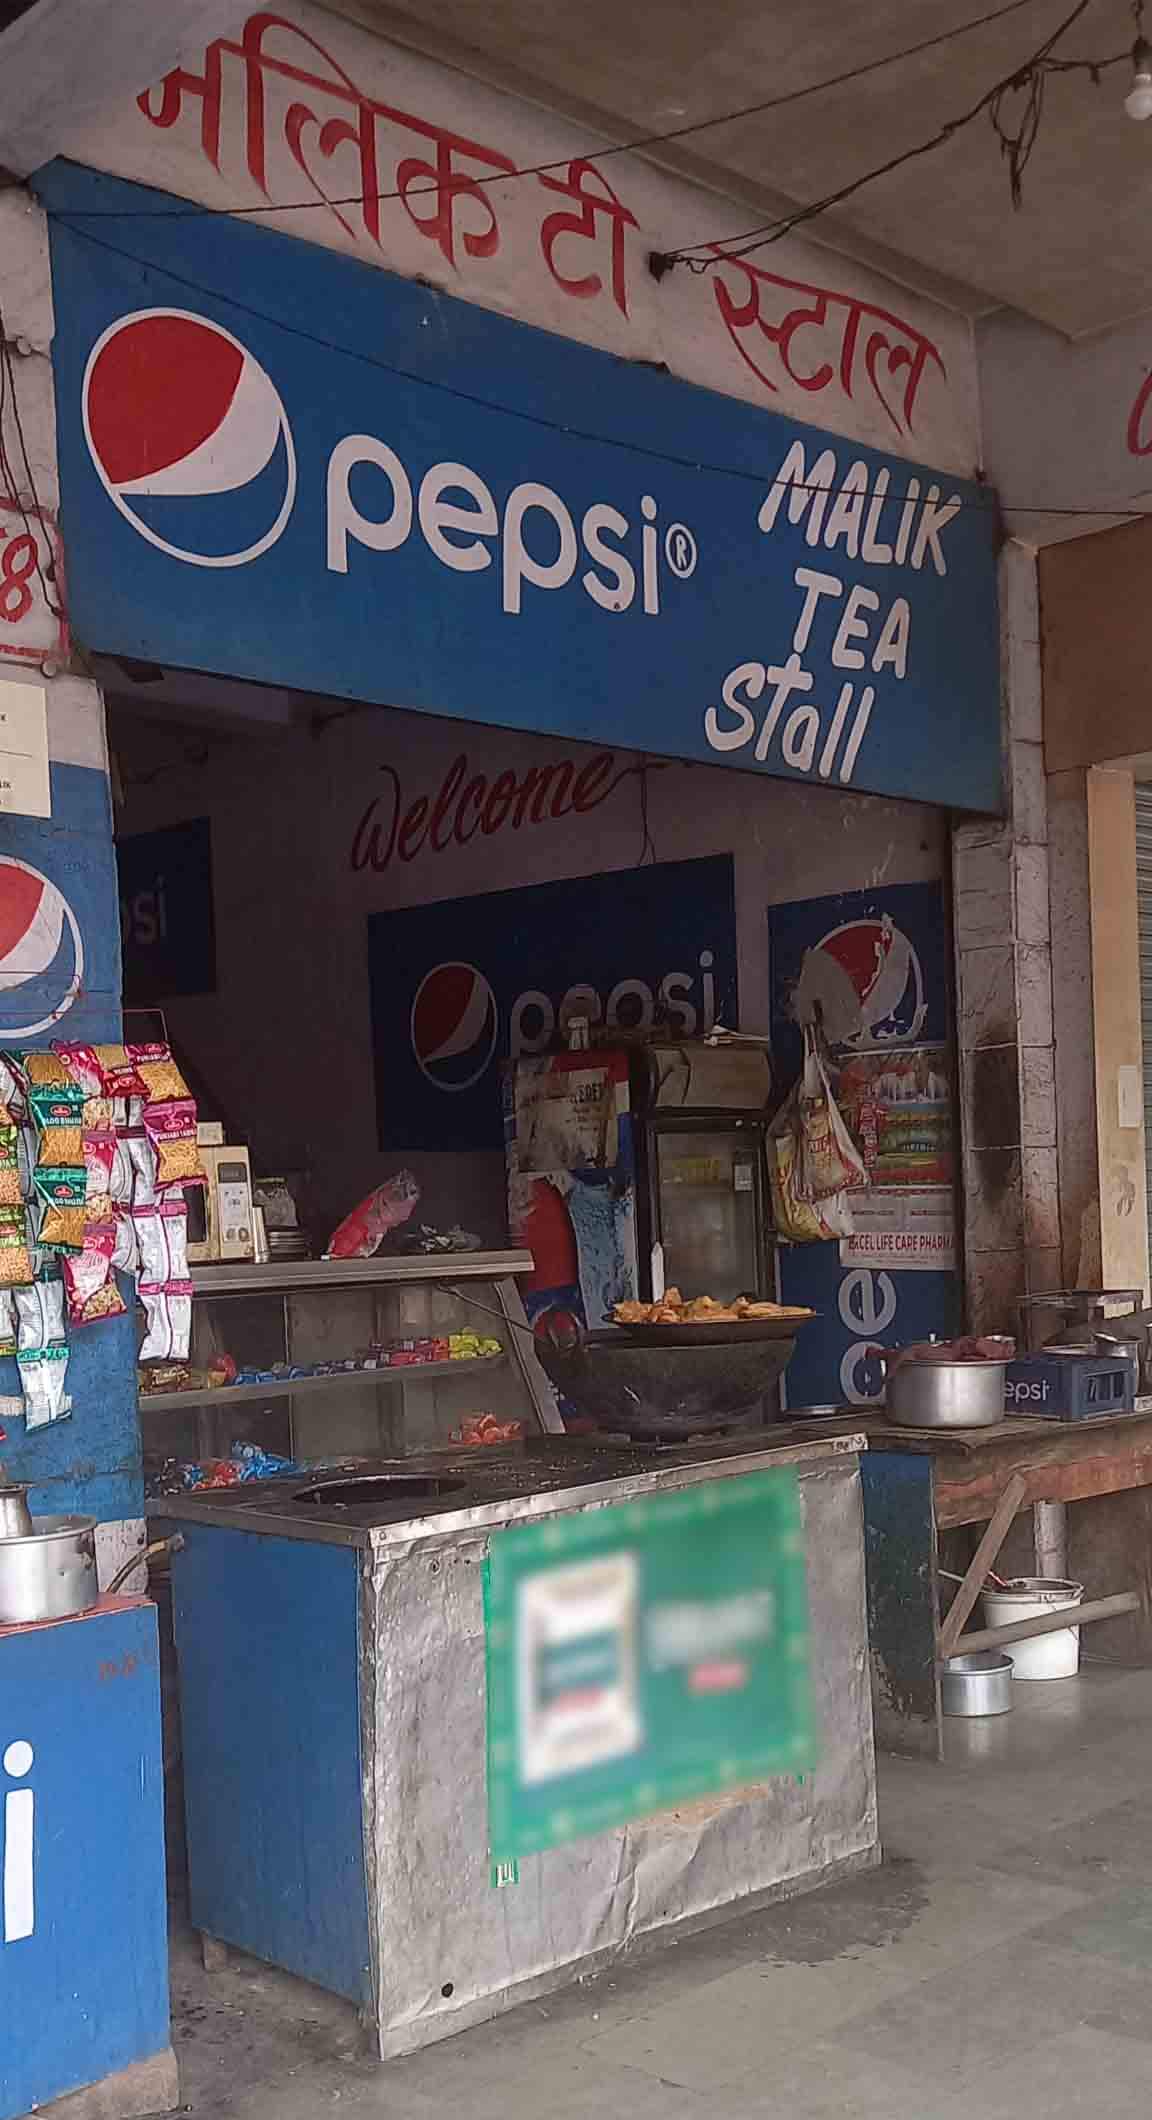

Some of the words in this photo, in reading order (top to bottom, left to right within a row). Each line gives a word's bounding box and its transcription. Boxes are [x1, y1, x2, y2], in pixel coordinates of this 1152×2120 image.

[536, 156, 641, 320] टी
[703, 242, 947, 435] स्टाल
[757, 440, 962, 576] MALIK
[794, 567, 911, 679] TEA
[703, 653, 875, 783] Stall
[351, 751, 643, 872] Welcome
[877, 1234, 894, 1249] LIFE
